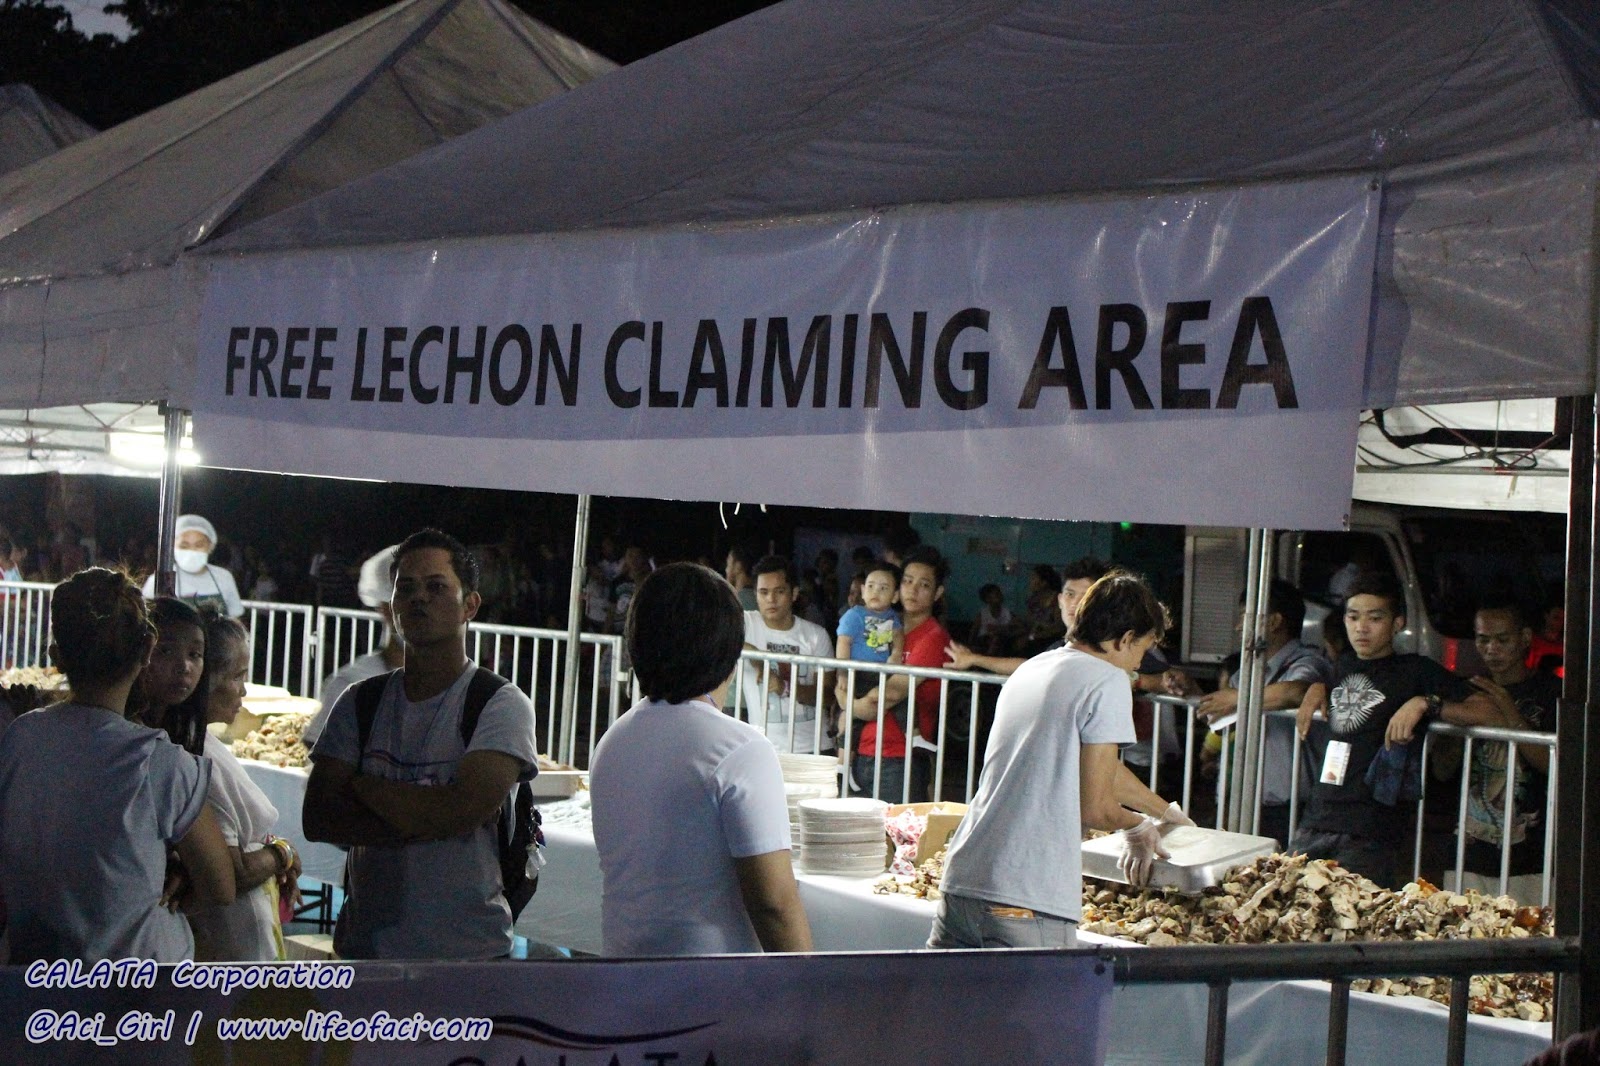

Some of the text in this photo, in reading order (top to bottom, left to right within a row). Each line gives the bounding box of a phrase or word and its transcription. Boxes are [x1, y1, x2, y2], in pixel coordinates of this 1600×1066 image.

[225, 296, 1299, 411] FREE LECHON CLAIMING AREA
